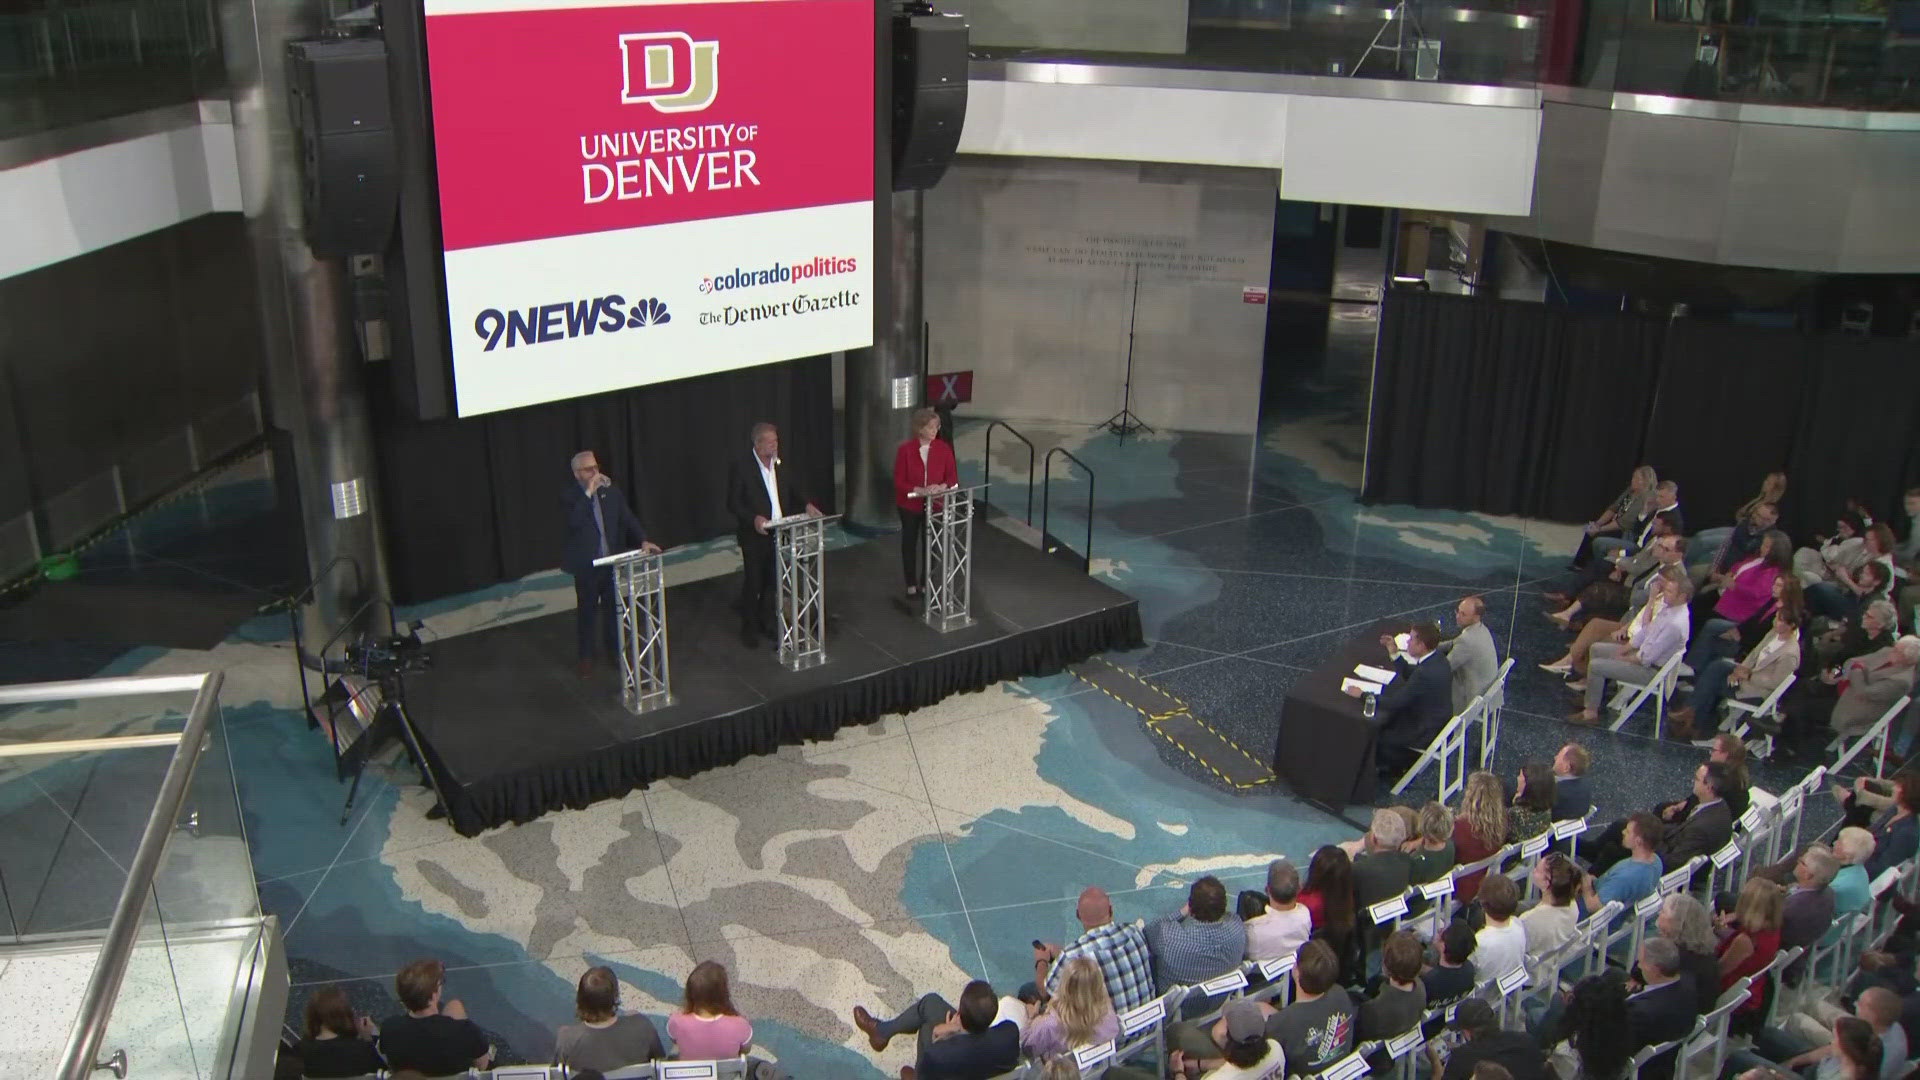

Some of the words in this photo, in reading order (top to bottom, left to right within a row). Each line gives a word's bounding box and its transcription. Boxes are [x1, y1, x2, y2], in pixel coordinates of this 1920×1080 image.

[580, 123, 735, 160] UNIVERSITY
[736, 125, 758, 142] OF
[582, 149, 761, 204] DENVER
[474, 294, 626, 353] 9NEWS
[699, 312, 722, 326] The
[723, 301, 790, 326] Denver
[792, 289, 860, 315] Gazette
